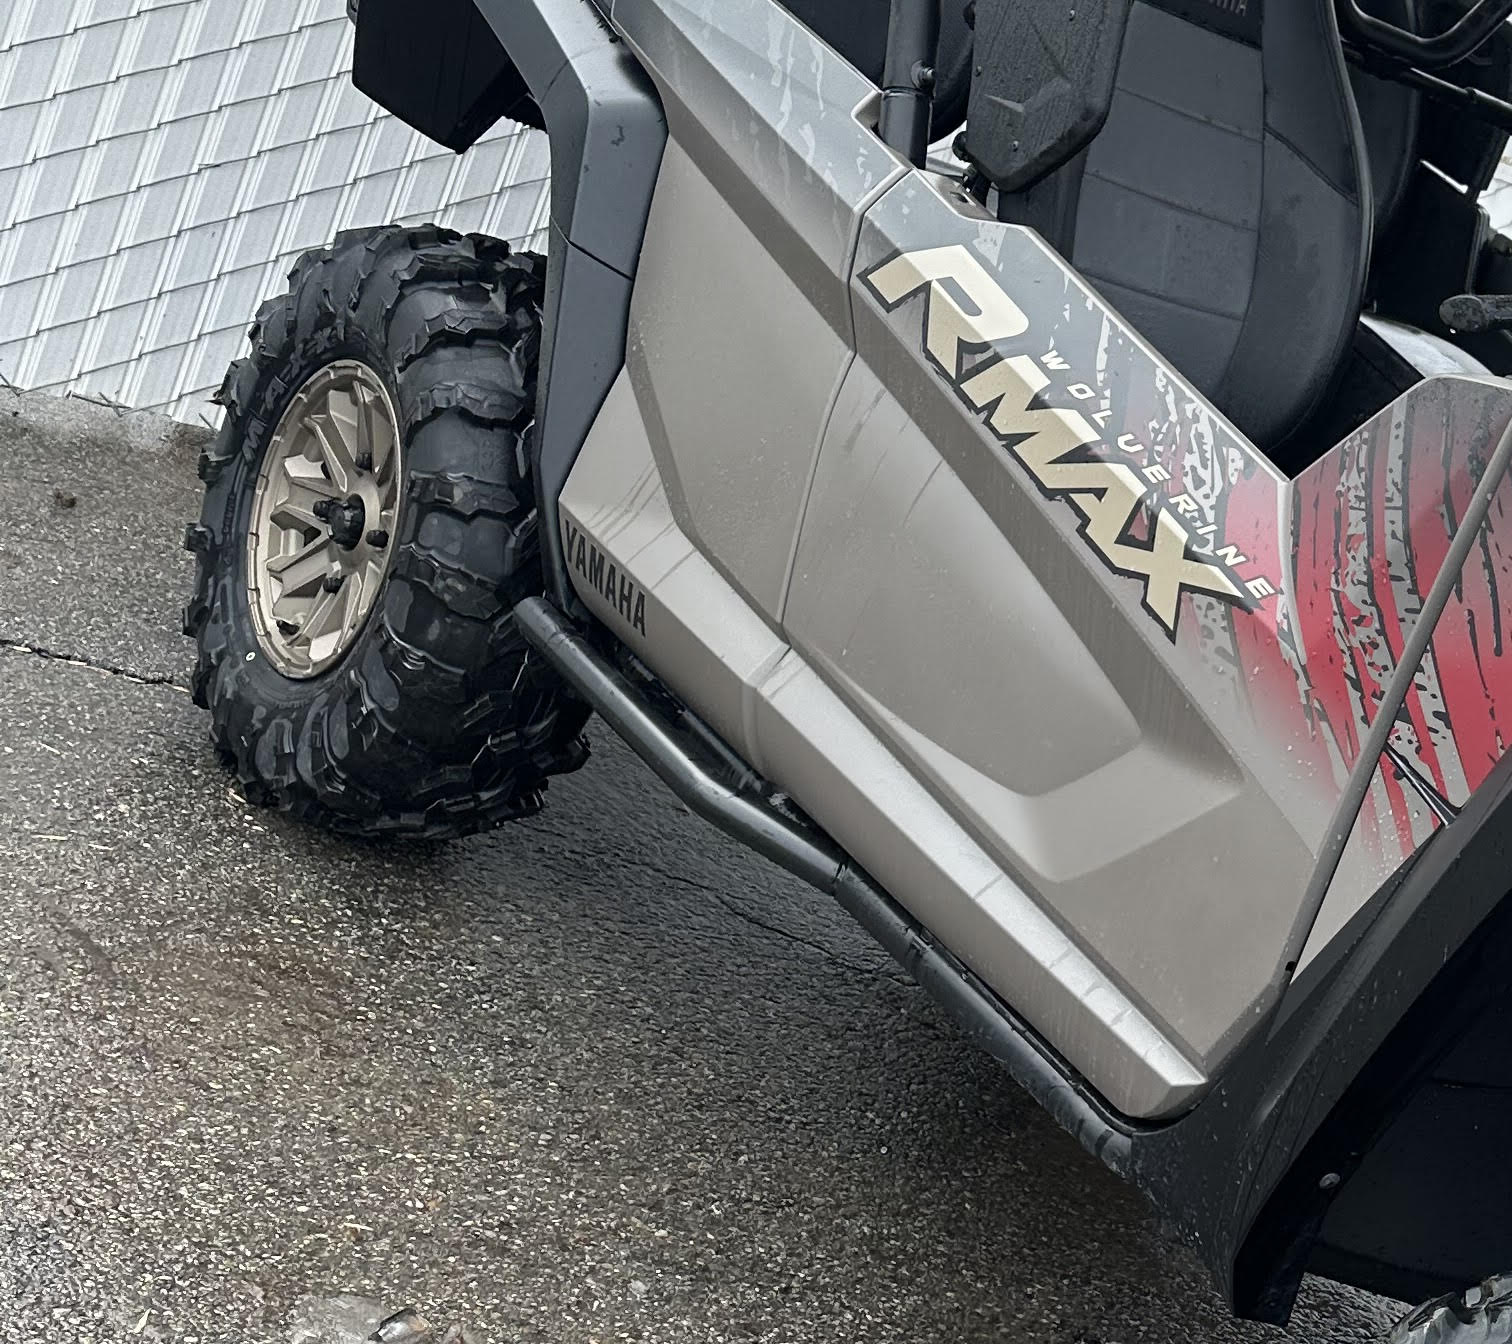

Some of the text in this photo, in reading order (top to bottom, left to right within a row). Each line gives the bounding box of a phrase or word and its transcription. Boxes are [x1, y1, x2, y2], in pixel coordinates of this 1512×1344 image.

[860, 244, 1257, 642] RMAX
[1039, 349, 1277, 599] WOLVERINE
[565, 519, 647, 639] YAMAHA
